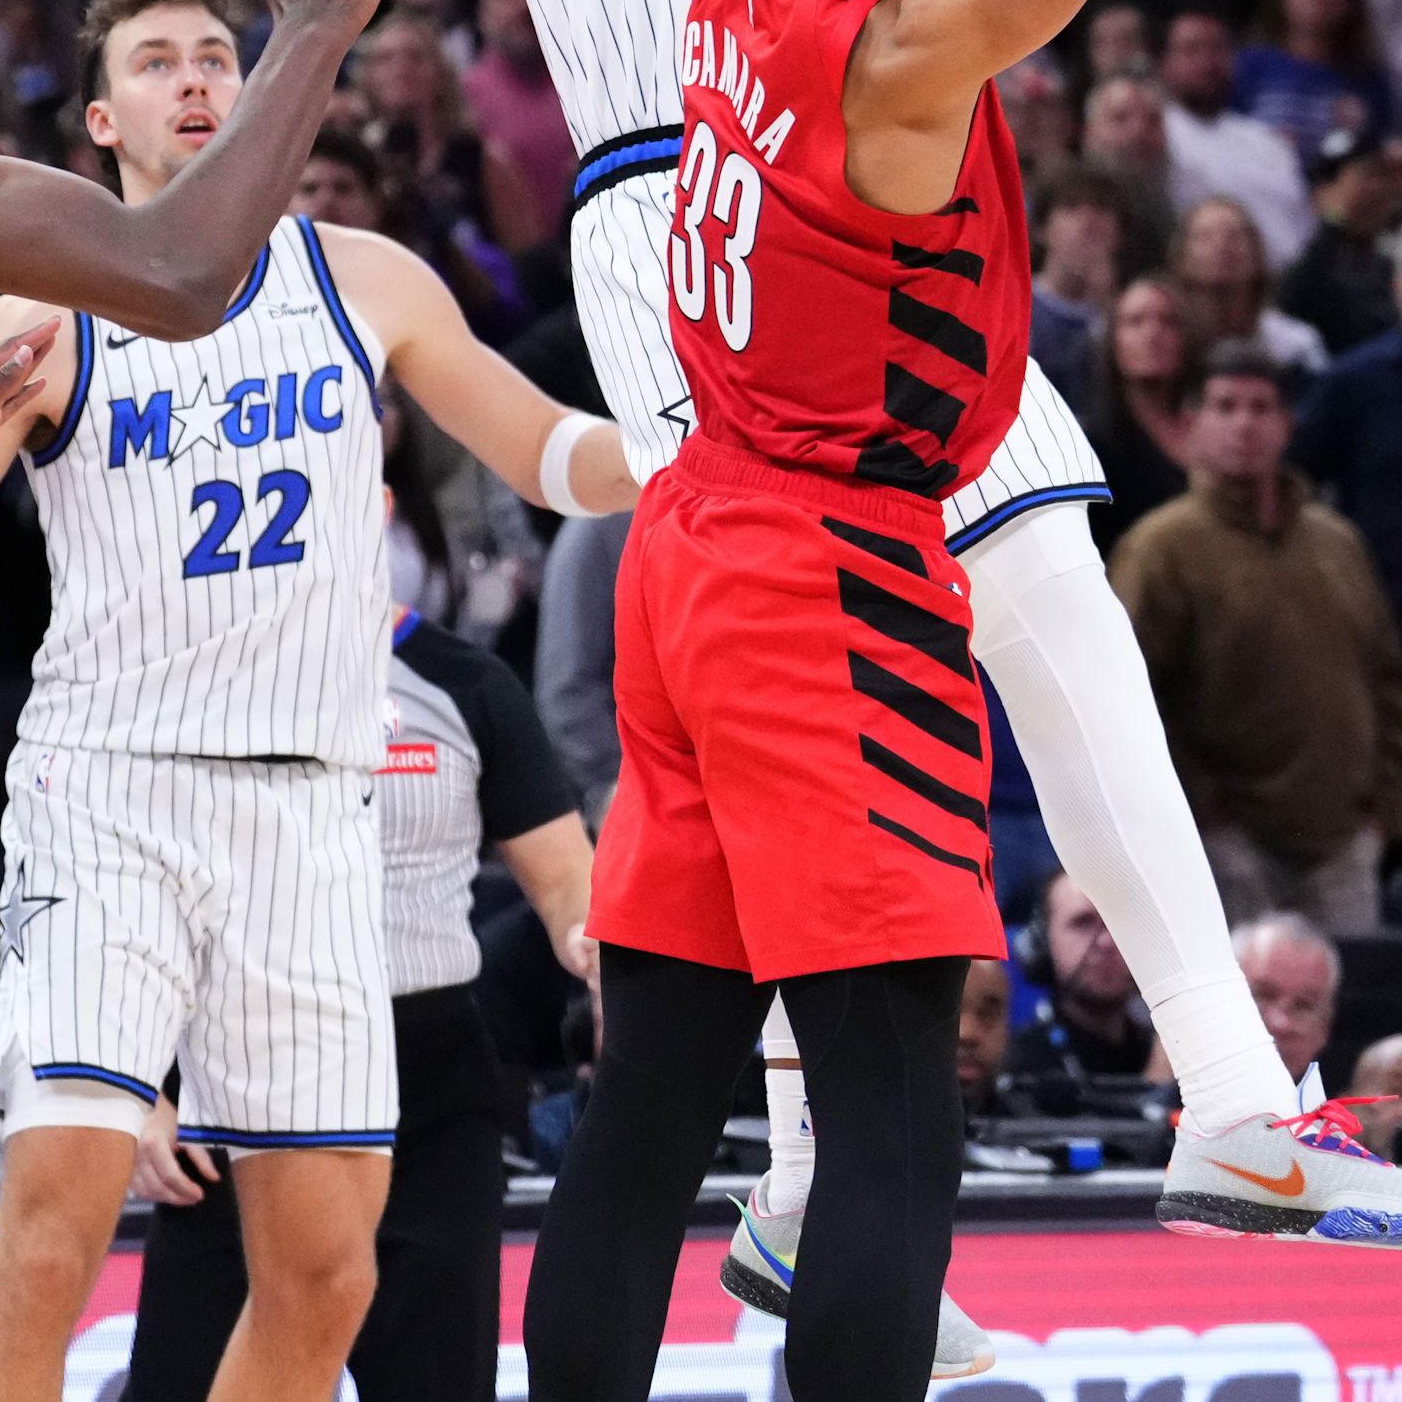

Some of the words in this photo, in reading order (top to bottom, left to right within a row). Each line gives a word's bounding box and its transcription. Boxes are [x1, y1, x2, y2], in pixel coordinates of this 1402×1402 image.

[682, 19, 796, 165] CAMARA
[670, 120, 762, 353] 33
[259, 302, 318, 319] Disney
[182, 468, 311, 579] 22
[388, 751, 434, 768] rates
